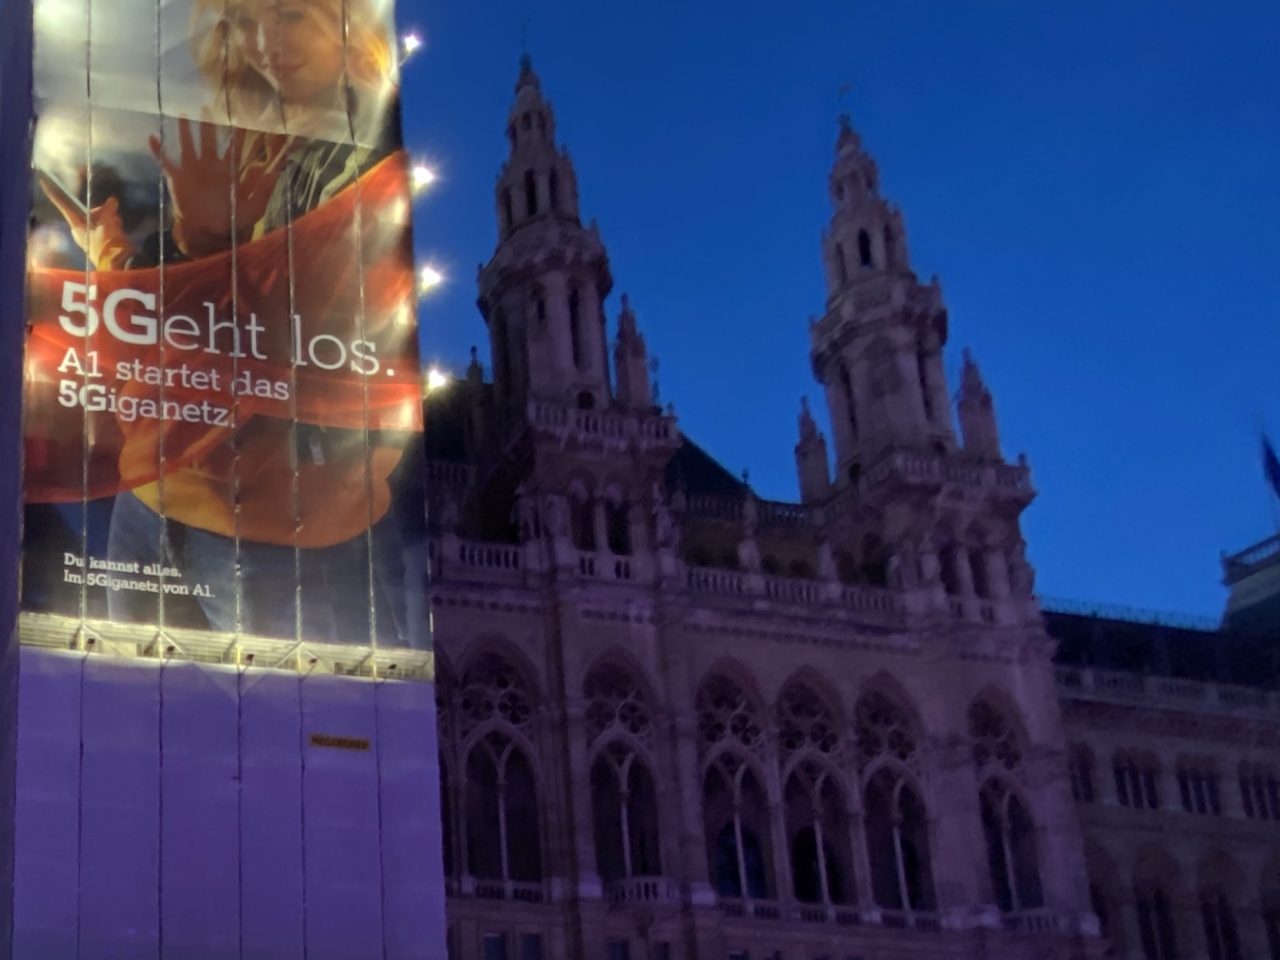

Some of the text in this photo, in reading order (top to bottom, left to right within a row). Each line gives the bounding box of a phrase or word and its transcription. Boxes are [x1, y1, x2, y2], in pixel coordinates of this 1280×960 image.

[58, 280, 395, 376] 5Geht los.
[58, 348, 289, 400] A1 startet das
[58, 379, 235, 428] 5Giganetz.
[63, 552, 182, 578] Du kannst alles.
[63, 569, 84, 584] Im
[87, 573, 159, 593] 5Giganetz
[162, 584, 189, 595] von
